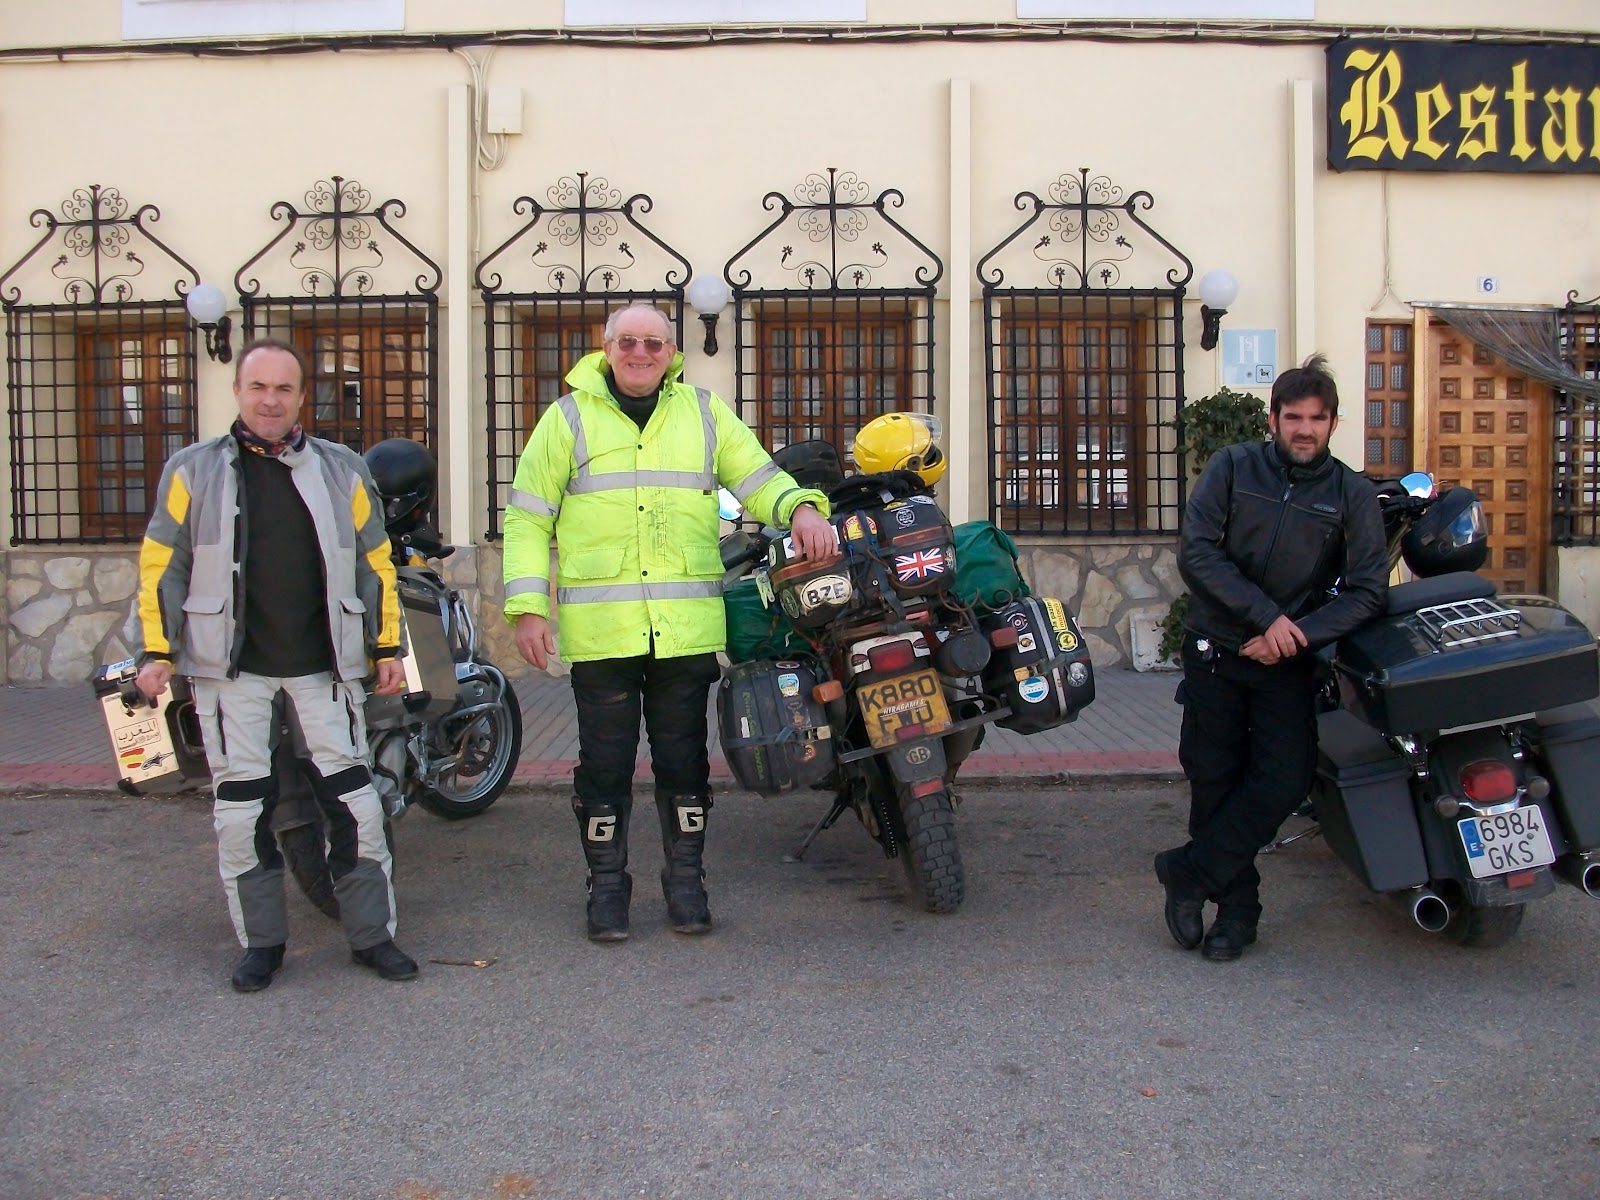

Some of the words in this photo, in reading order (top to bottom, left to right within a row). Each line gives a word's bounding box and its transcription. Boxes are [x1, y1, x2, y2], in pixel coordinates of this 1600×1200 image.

[1482, 278, 1494, 292] 6
[860, 674, 937, 713] K880
[118, 720, 157, 742] المغرب
[908, 747, 928, 764] GB
[587, 815, 617, 842] G
[677, 806, 704, 833] G
[1479, 809, 1540, 842] 6984
[1470, 843, 1479, 852] E
[1487, 840, 1534, 870] GKS
